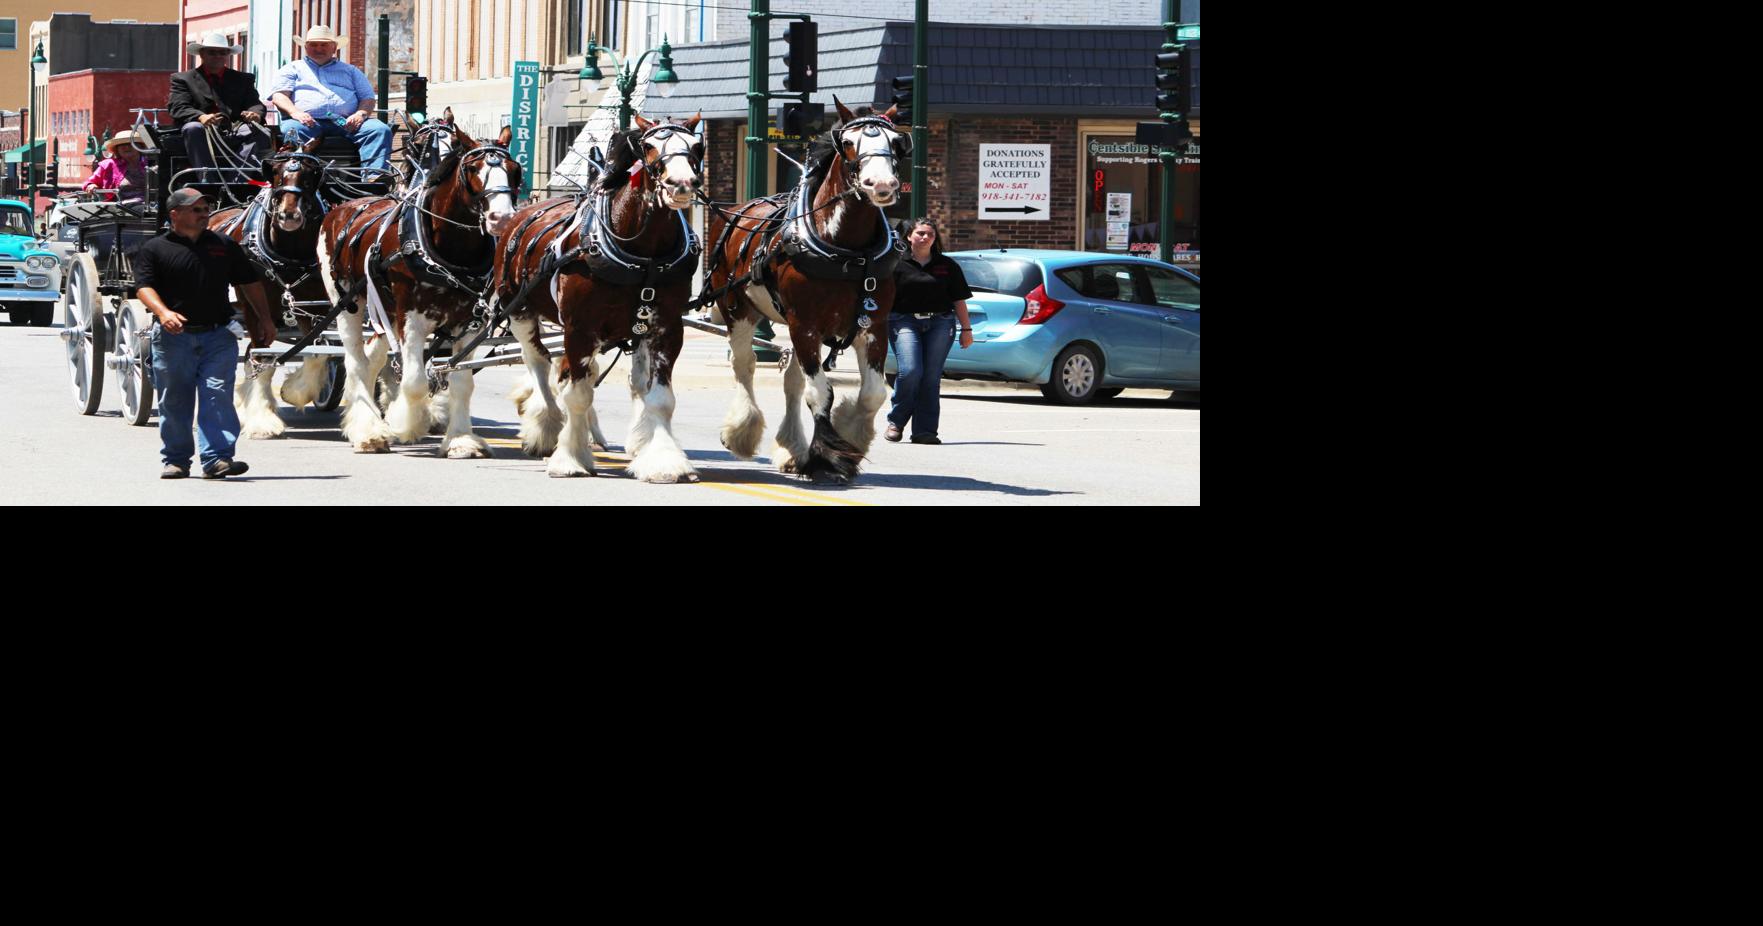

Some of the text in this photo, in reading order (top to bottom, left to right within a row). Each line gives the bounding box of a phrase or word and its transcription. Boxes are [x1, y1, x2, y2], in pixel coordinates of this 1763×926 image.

[517, 65, 538, 73] THE
[1097, 156, 1133, 164] Supporting
[1134, 156, 1157, 164] Rogers
[1129, 243, 1158, 251] MON
